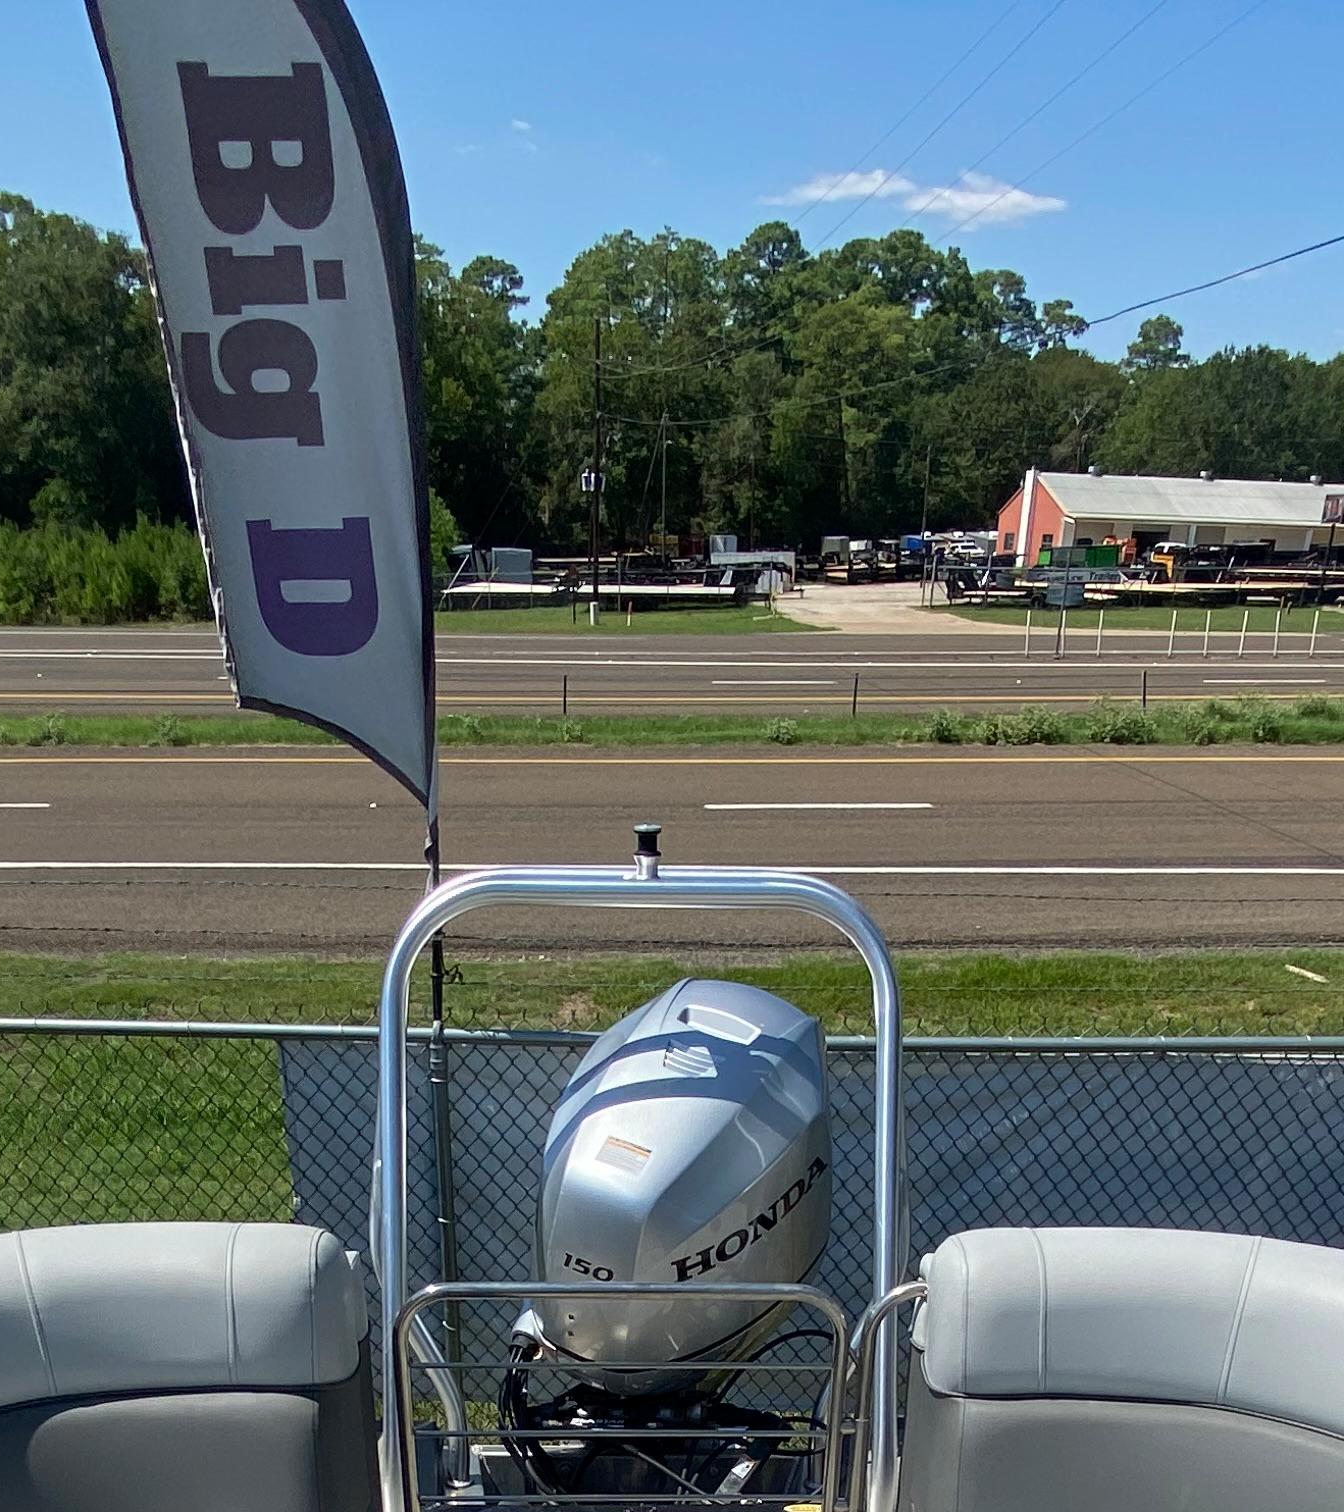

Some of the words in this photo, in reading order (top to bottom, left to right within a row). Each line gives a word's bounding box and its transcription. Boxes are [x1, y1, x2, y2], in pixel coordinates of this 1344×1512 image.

[177, 61, 347, 446] Big
[246, 516, 378, 656] D
[563, 1252, 614, 1282] 150
[670, 1156, 828, 1282] HONDA
